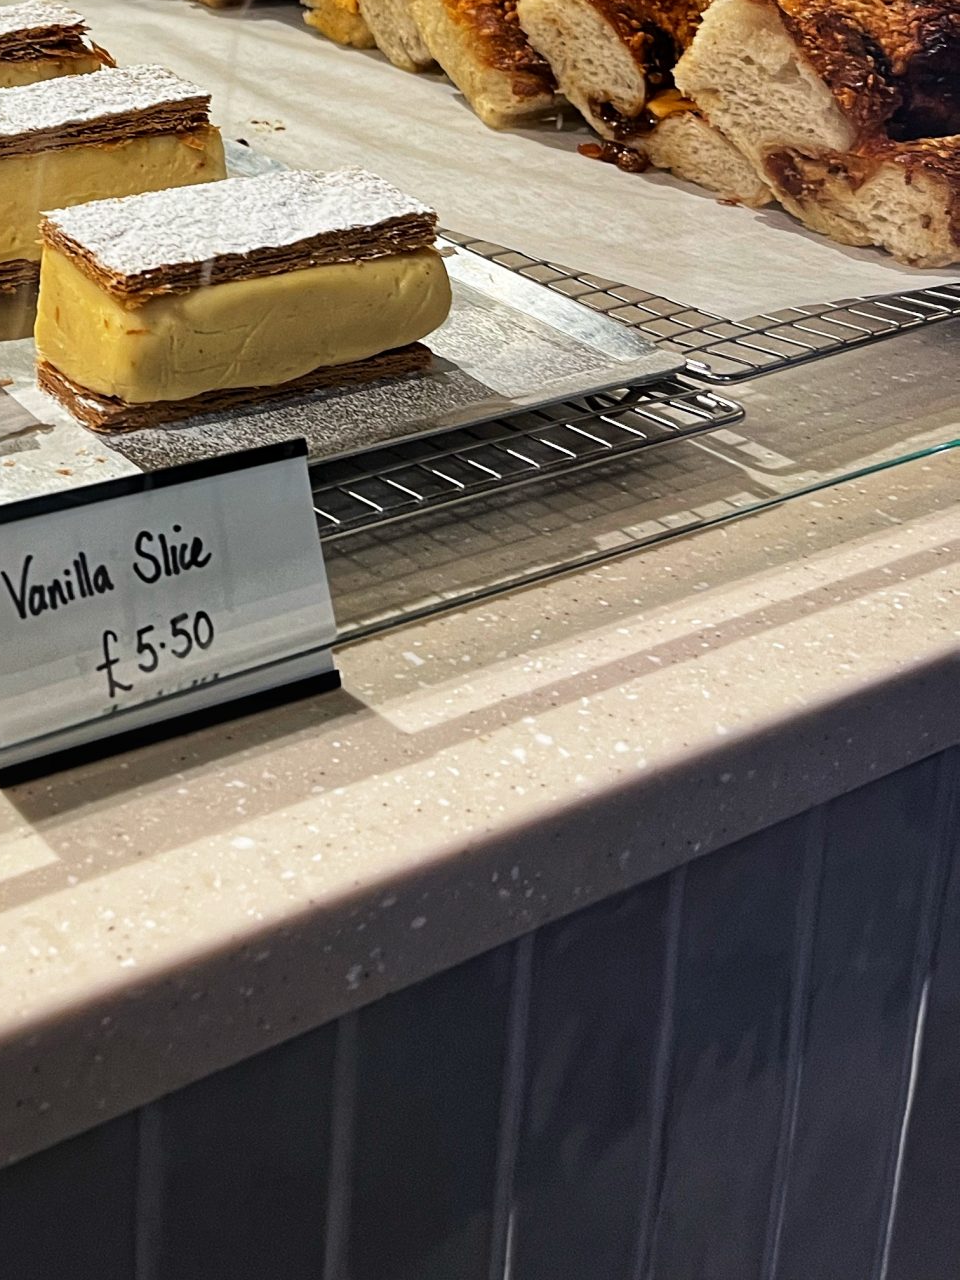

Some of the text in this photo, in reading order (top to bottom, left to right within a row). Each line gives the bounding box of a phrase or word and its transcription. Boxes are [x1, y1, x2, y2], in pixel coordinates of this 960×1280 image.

[1, 524, 212, 619] Vanilla Slice
[96, 610, 214, 698] £5.50
